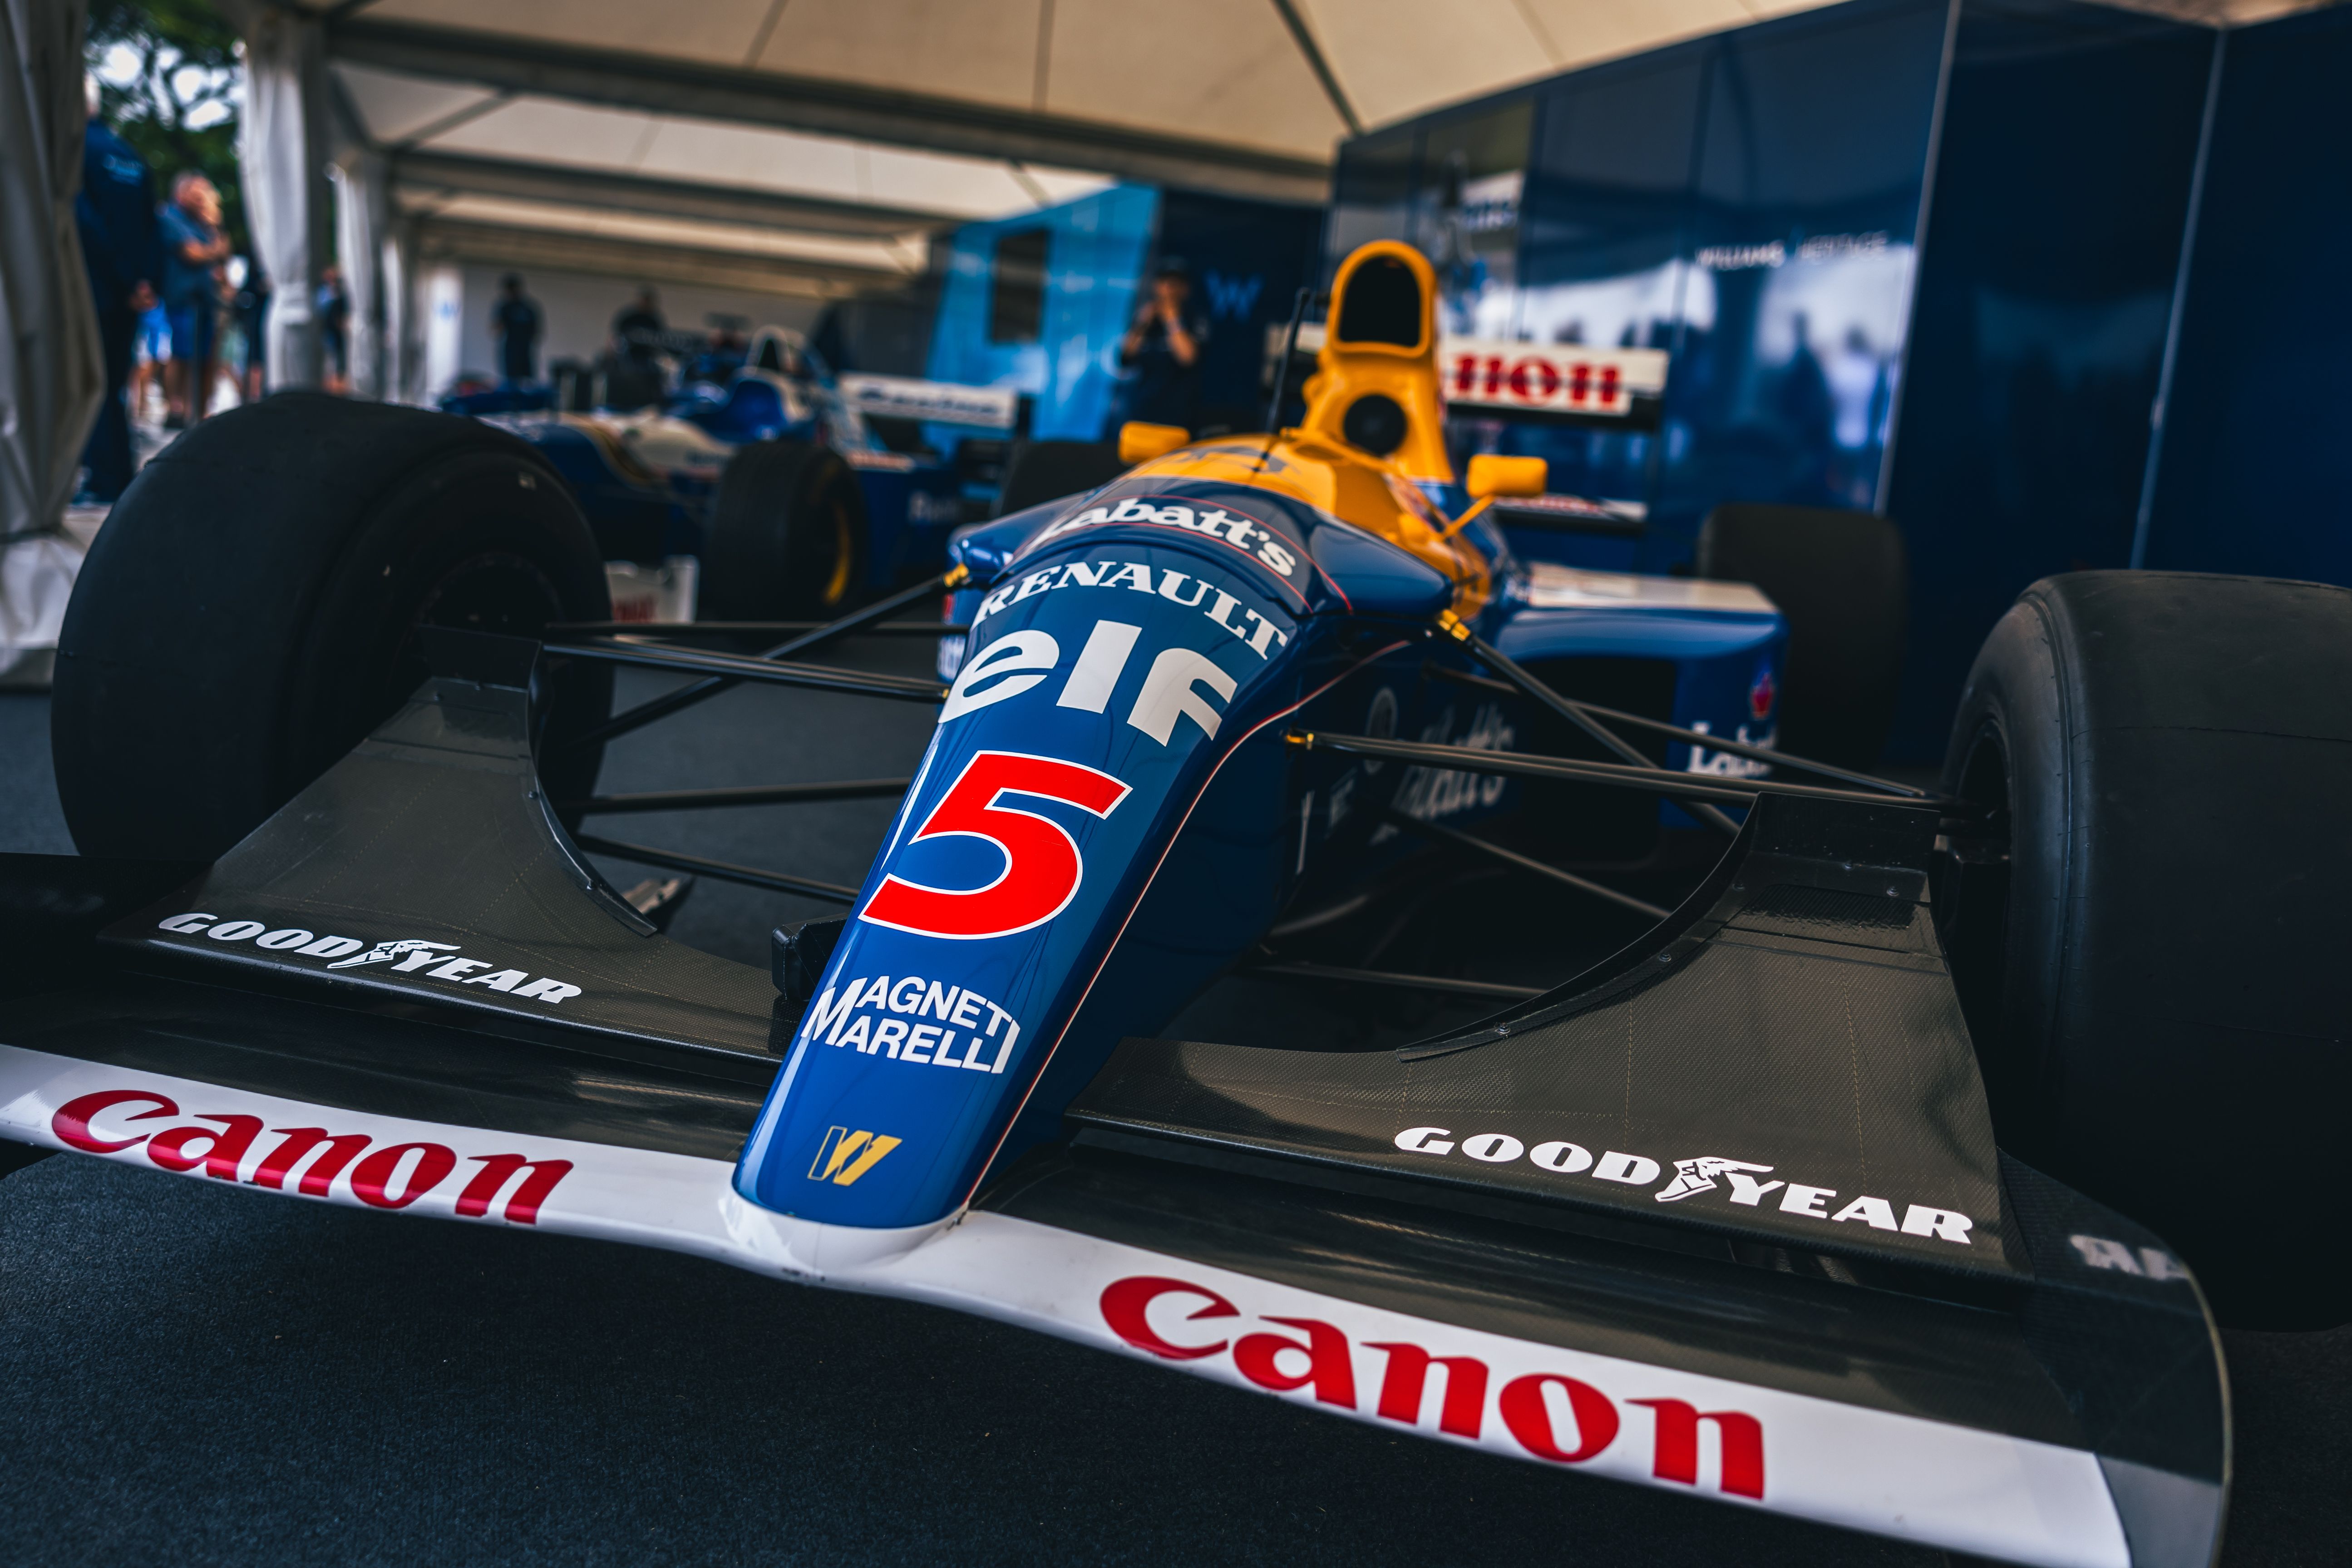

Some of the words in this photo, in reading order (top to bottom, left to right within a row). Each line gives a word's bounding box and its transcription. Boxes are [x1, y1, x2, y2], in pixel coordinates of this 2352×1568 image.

[971, 561, 1288, 661] RENAULT
[938, 619, 1238, 747] elf
[857, 749, 1133, 940] 5
[800, 975, 1021, 1049] MAGNETI
[800, 992, 1021, 1074] MARELLI
[51, 1089, 574, 1225] Canon
[1099, 1275, 1765, 1501] Canon
